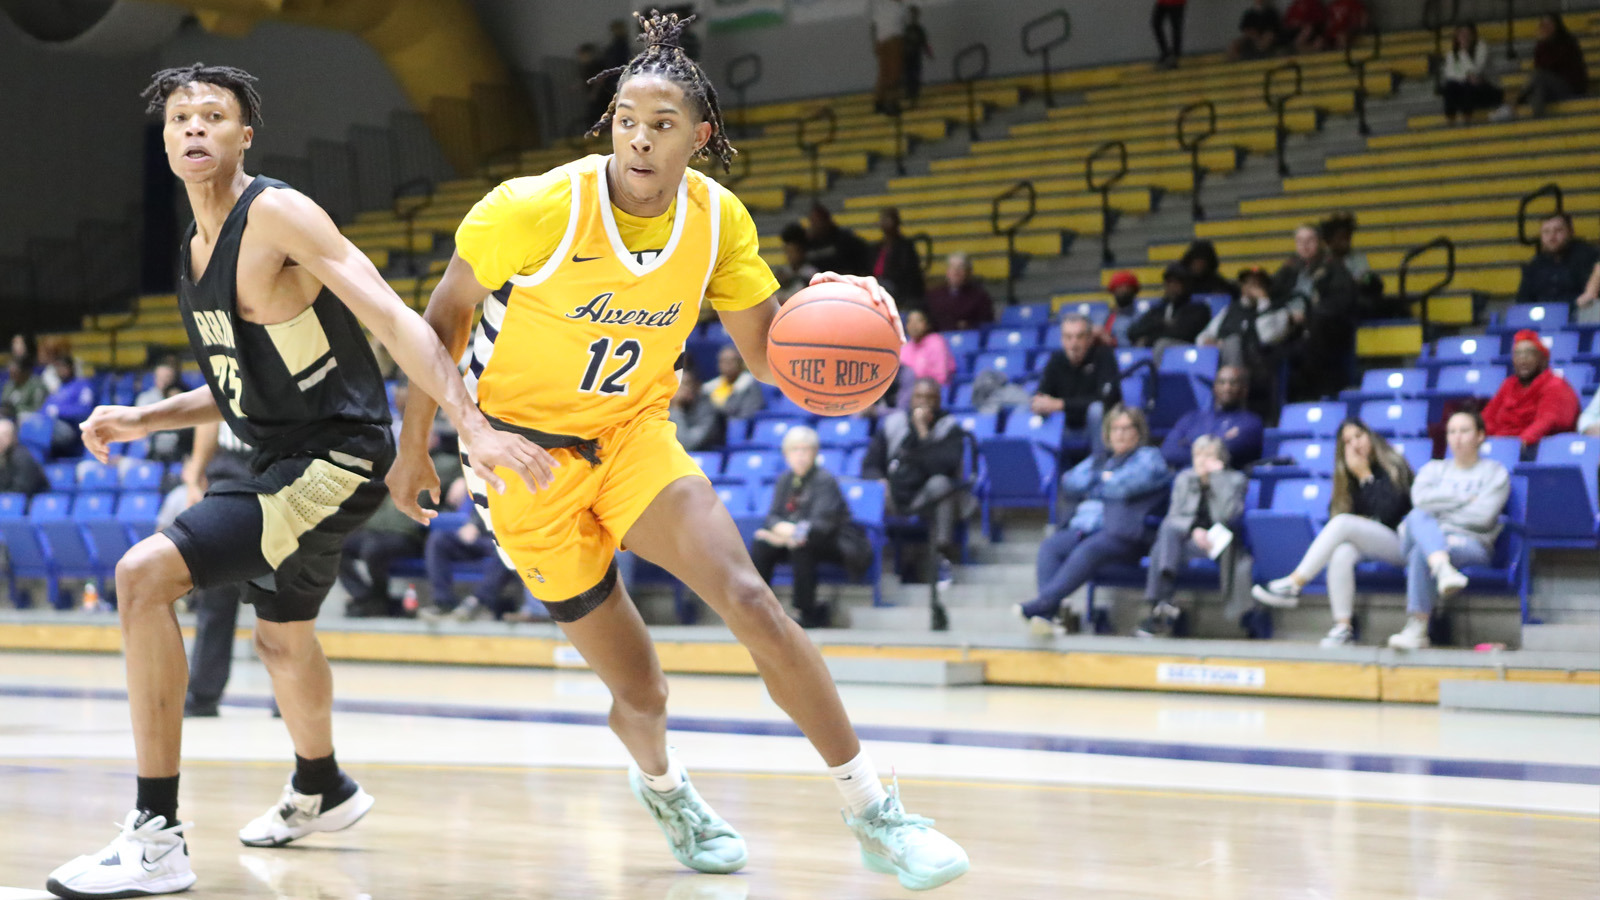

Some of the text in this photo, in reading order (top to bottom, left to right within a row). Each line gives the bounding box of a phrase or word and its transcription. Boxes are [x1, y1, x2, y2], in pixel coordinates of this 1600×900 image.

[566, 292, 683, 327] Averett
[578, 336, 642, 396] 12
[789, 359, 880, 386] THE ROCK
